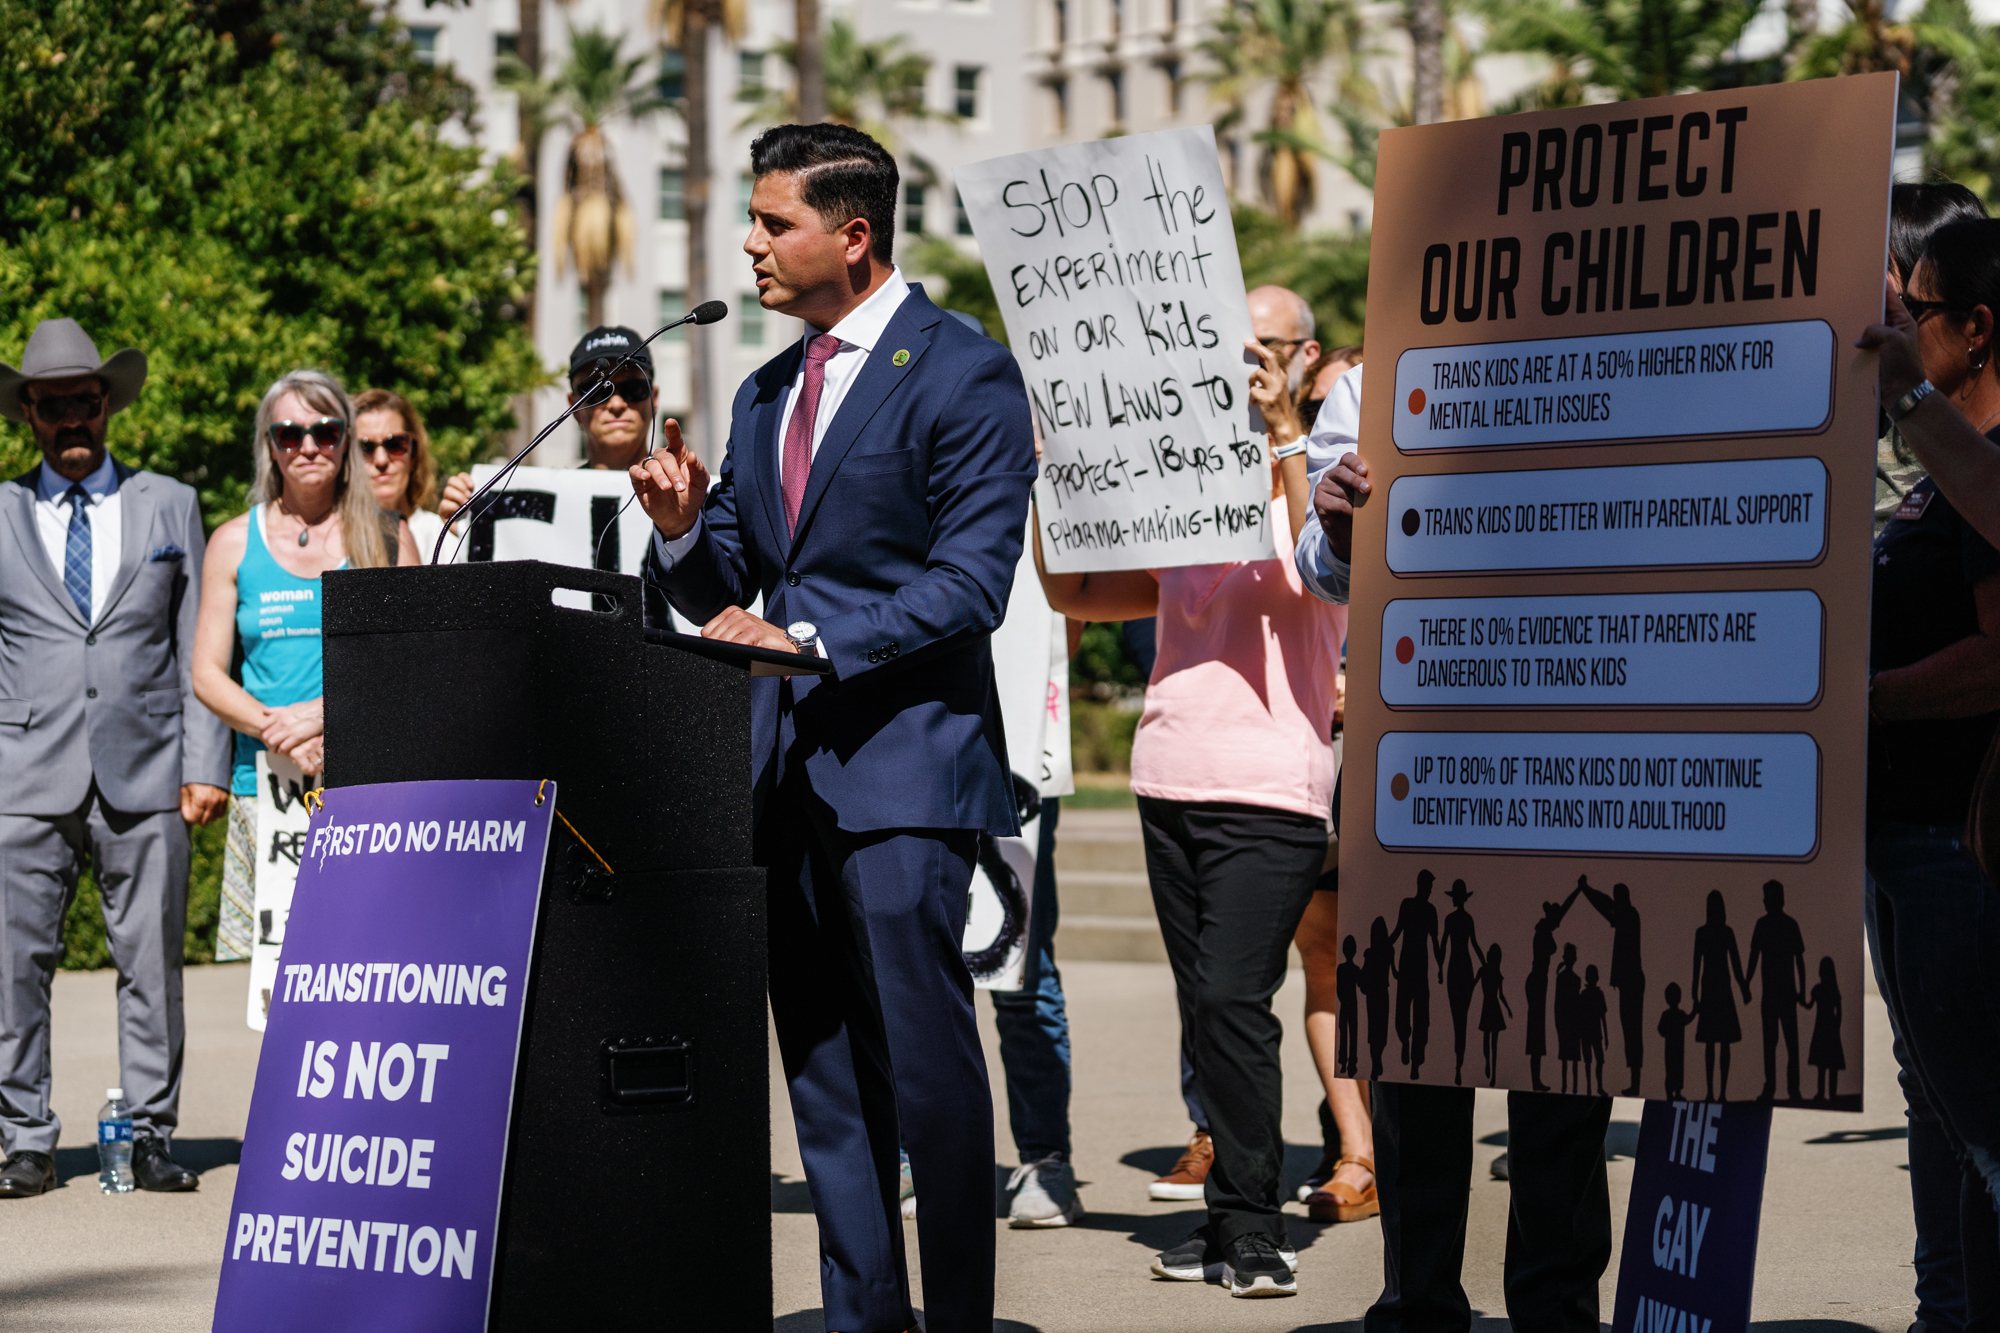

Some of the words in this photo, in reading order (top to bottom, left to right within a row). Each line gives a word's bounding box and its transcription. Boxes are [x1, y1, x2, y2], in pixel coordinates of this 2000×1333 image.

[1497, 106, 1748, 216] PROTECT
[1420, 236, 1522, 326] OUR
[1540, 208, 1821, 317] CHILDREN
[1432, 359, 1482, 390] TRANS
[1484, 357, 1520, 387] KIDS
[1522, 355, 1554, 385] ARE
[1556, 353, 1579, 383] AT
[1581, 352, 1593, 381] A
[1596, 349, 1634, 380] 50%
[1637, 345, 1696, 378] HIGHER
[1699, 342, 1738, 374] RISK
[1741, 339, 1774, 371] FOR
[1429, 399, 1490, 431] MENTAL
[1493, 395, 1554, 427] HEALTH
[1556, 392, 1611, 424] ISSUES
[1424, 506, 1474, 536] TRANS
[1476, 505, 1512, 535] KIDS
[1514, 504, 1536, 533] DO
[1539, 501, 1598, 532] BETTER
[1602, 499, 1643, 530] WITH
[1646, 496, 1732, 529] PARENTAL
[1736, 492, 1814, 526] SUPPORT
[259, 588, 314, 603] woman
[1419, 617, 1467, 647] THERE
[1470, 617, 1485, 646] IS
[1488, 617, 1514, 646] 0%
[1518, 615, 1594, 645] EVIDENCE
[1597, 614, 1641, 644] THAT
[1643, 612, 1719, 644] PARENTS
[1722, 612, 1757, 642] ARE
[1417, 658, 1508, 688] DANGEROUS
[1510, 658, 1531, 687] TO
[1534, 657, 1585, 687] TRANS
[1590, 656, 1627, 687] KIDS
[1414, 756, 1434, 784] UP
[1437, 756, 1456, 785] TO
[1459, 756, 1496, 785] 80%
[1499, 756, 1520, 786] OF
[1522, 756, 1575, 787] TRANS
[1578, 757, 1615, 787] KIDS
[1619, 757, 1641, 787] DO
[1644, 757, 1678, 788] NOT
[1681, 757, 1763, 789] CONTINUE
[1412, 796, 1503, 827] IDENTIFYING
[1506, 798, 1528, 828] AS
[1531, 798, 1585, 829] TRANS
[1588, 799, 1624, 830] INTO
[1627, 800, 1726, 832] ADULTHOOD
[367, 821, 403, 855] DO
[404, 820, 441, 853] NO
[444, 820, 527, 853] HARM
[282, 962, 508, 1007] TRANSITIONING
[296, 1040, 340, 1099] IS
[342, 1040, 450, 1103] NOT
[280, 1131, 435, 1189] SUICIDE
[1668, 1101, 1723, 1174] THE
[231, 1211, 478, 1281] PREVENTION
[1652, 1194, 1712, 1279] GAY
